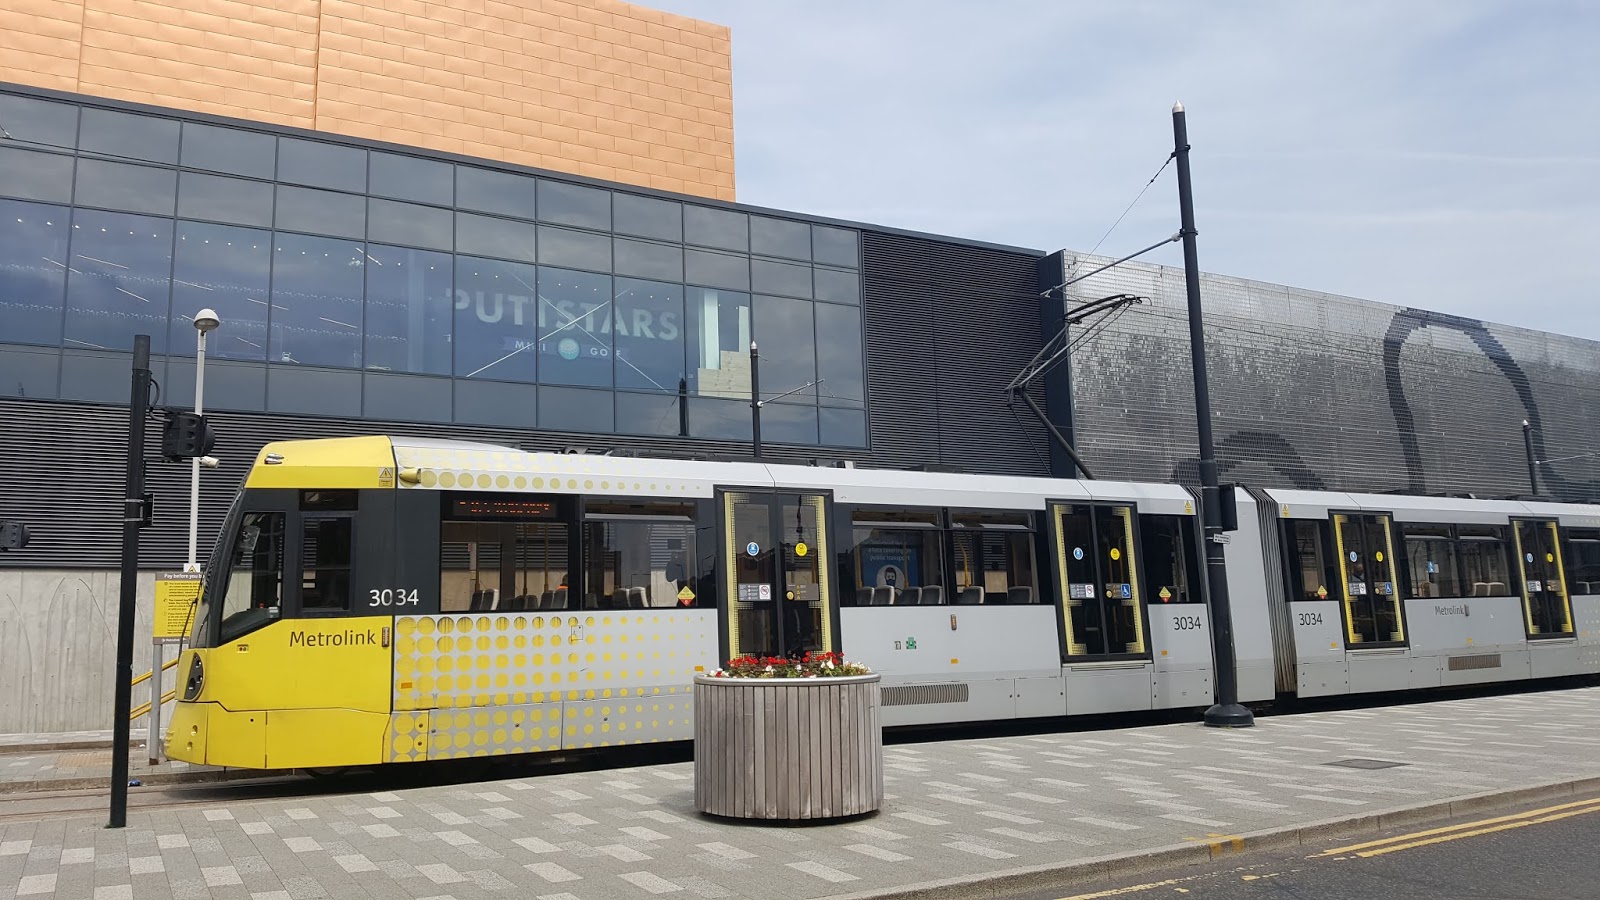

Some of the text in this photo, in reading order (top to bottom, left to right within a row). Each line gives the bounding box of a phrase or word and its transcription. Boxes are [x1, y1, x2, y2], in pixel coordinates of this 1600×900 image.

[445, 288, 678, 341] PUTTSTARS
[590, 347, 621, 358] GOF
[369, 588, 419, 607] 3034
[1434, 605, 1465, 616] Metrolink
[1173, 616, 1201, 630] 3034
[1299, 612, 1323, 626] 3034
[290, 630, 376, 647] Metrolink
